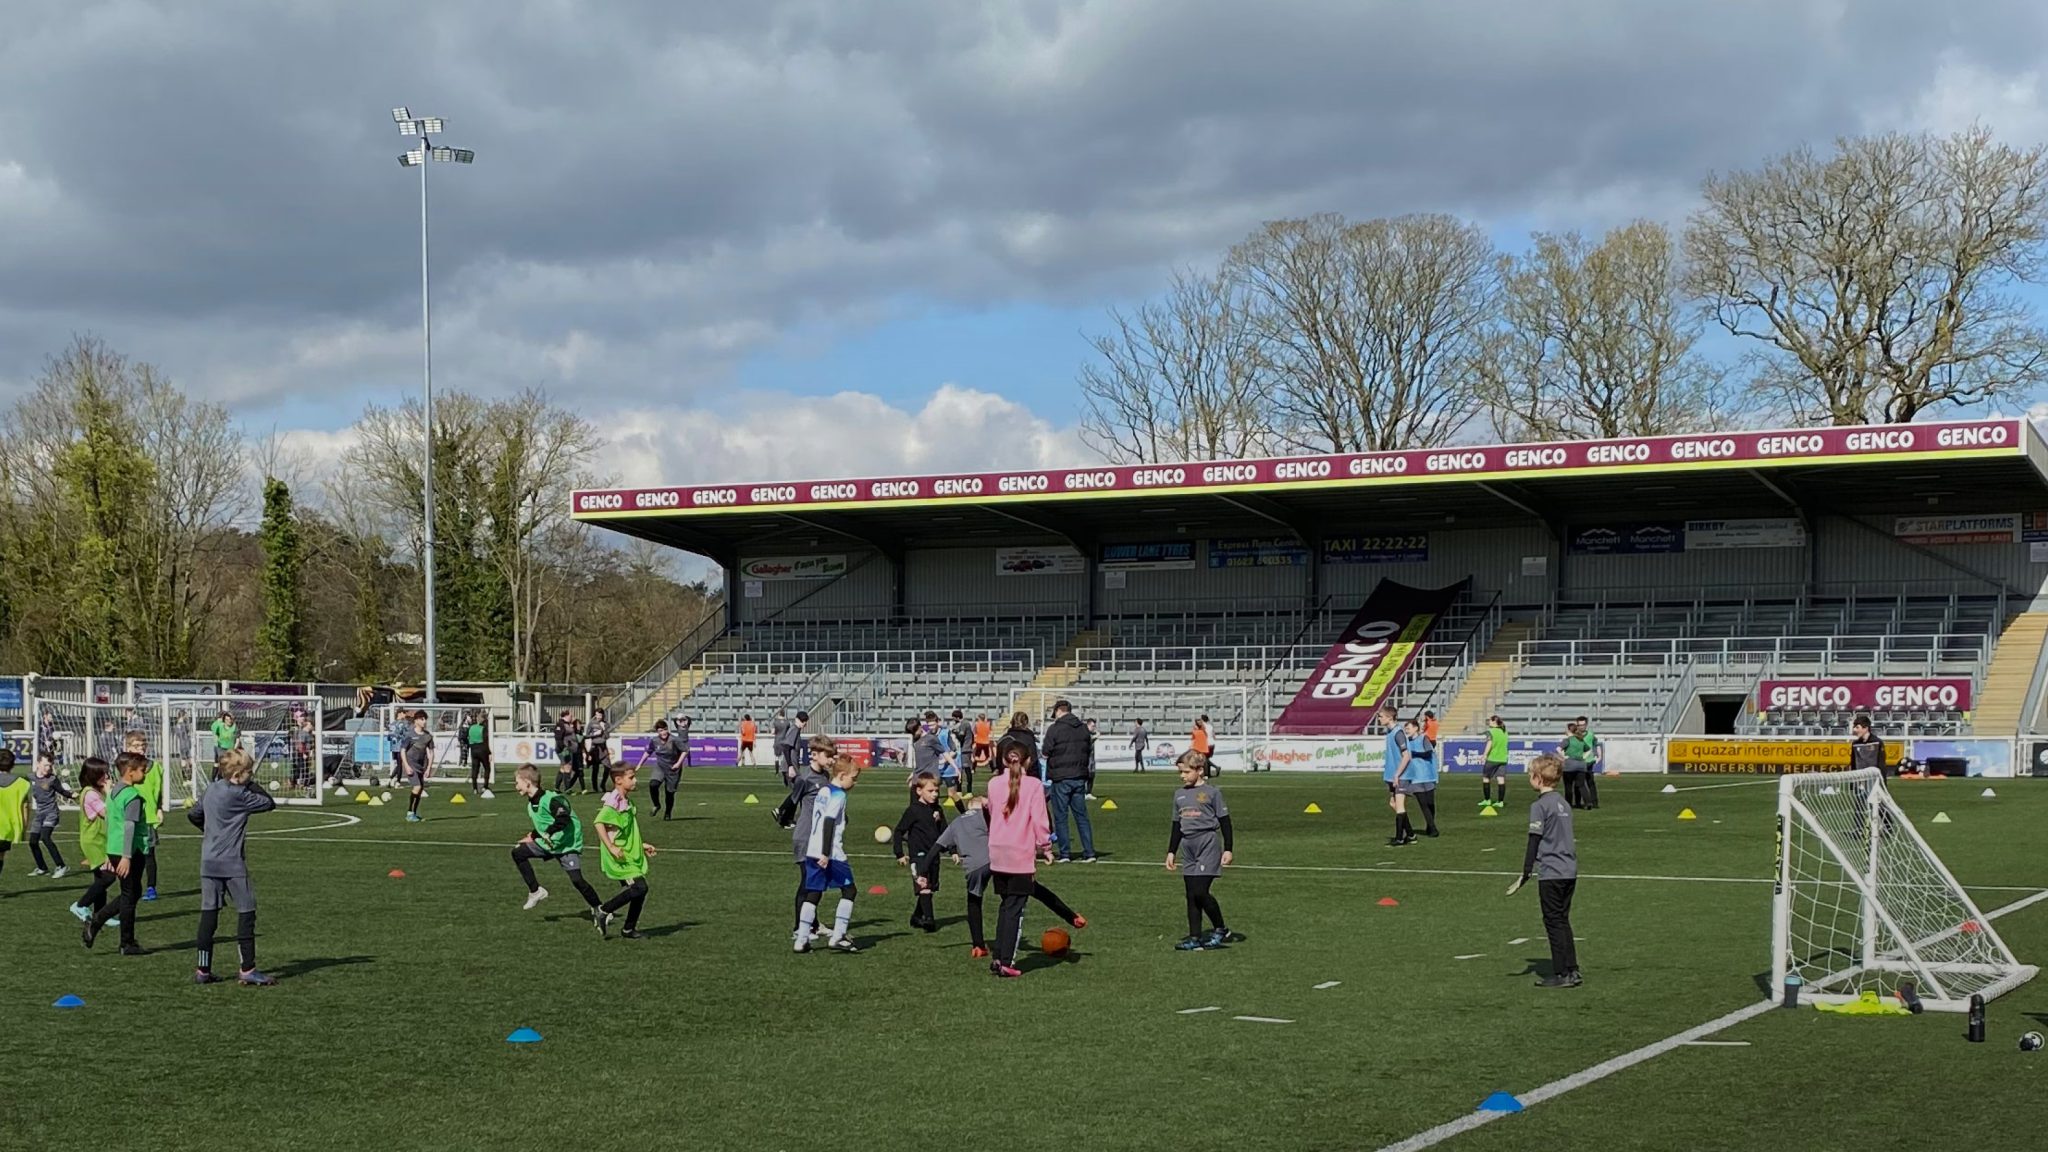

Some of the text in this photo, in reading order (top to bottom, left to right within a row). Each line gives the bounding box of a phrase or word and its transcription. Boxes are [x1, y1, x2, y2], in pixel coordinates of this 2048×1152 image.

[579, 425, 2008, 510] GENCO GENCO GENCO GENCO GENCO GENCO GENCO GENCO GENCO GENCO GENCO GENCO GENCO GENCO GENCO GENCO GENCO GENCO GENCO GENCO
[1323, 540, 1357, 551] TAXI
[751, 563, 792, 576] Gallagher
[1312, 621, 1400, 699] GENCO
[1771, 685, 1959, 706] GENCO GENCO
[1685, 763, 1755, 773] PIONEERS
[1762, 763, 1776, 773] IN
